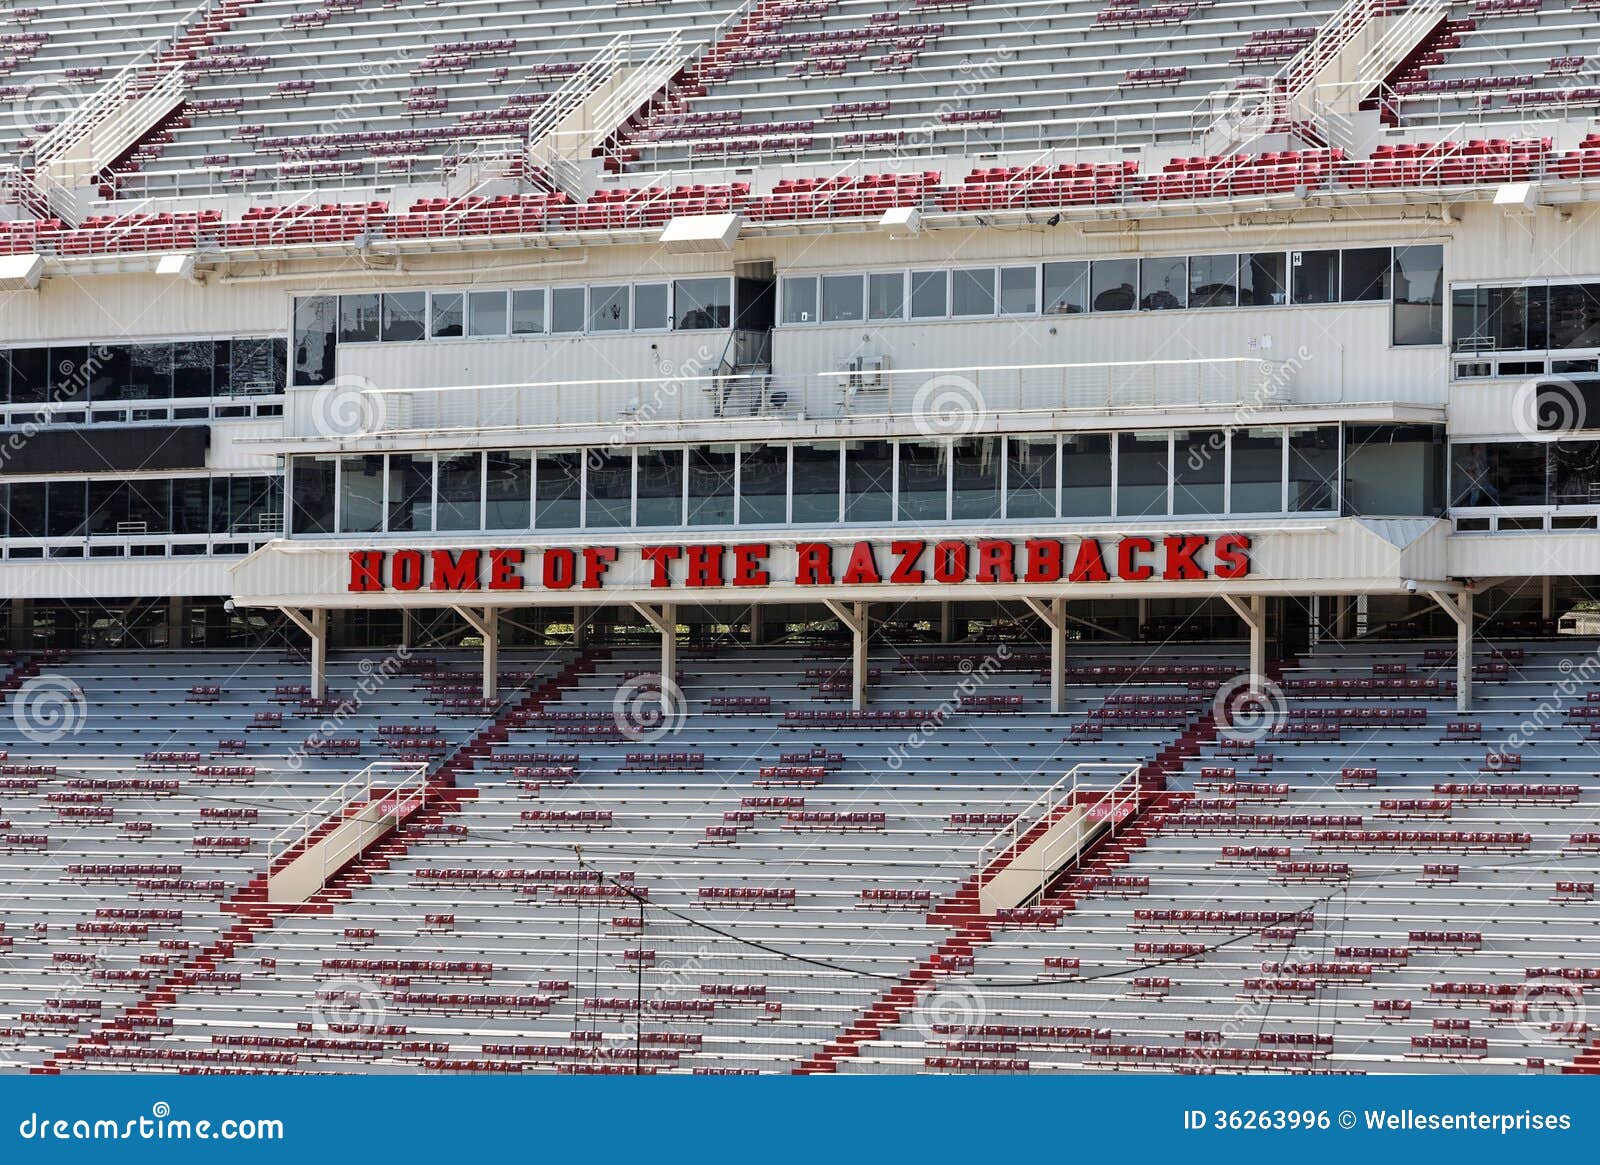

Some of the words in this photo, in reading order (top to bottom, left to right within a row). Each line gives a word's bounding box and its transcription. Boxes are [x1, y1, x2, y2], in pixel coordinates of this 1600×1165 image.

[348, 548, 524, 592] HOME
[543, 547, 619, 590] OF
[642, 543, 770, 588] THE
[795, 534, 1252, 585] RAZORBACKS
